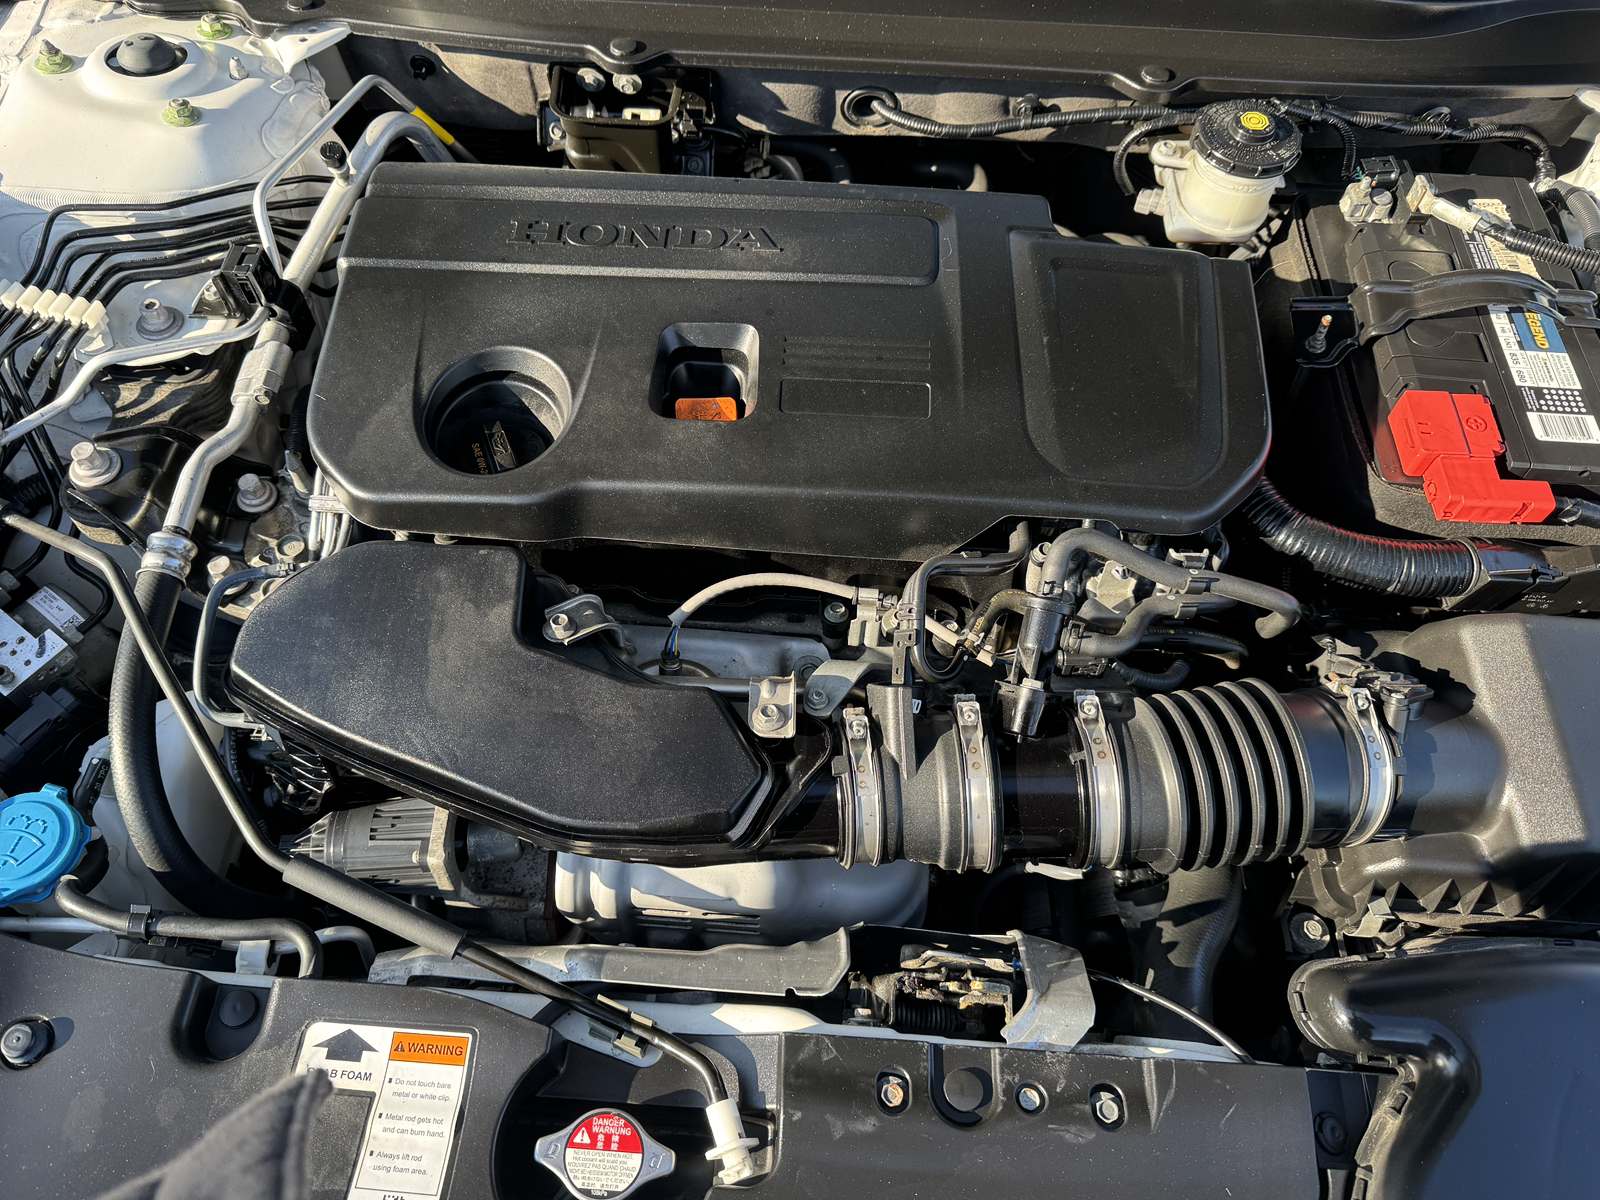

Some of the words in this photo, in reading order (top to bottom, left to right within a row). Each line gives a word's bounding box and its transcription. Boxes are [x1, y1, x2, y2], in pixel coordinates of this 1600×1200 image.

[506, 220, 784, 252] HONDA
[1524, 308, 1550, 349] EGEND
[1509, 352, 1520, 365] 835
[1516, 370, 1527, 383] 680
[472, 443, 483, 457] SAE
[477, 458, 488, 475] 0W-2
[98, 765, 108, 778] TPC
[407, 1042, 463, 1056] WARNING
[340, 1070, 372, 1081] FOAM
[438, 1094, 451, 1102] clip.
[592, 1117, 625, 1127] DANGER
[410, 1128, 425, 1136] burn
[427, 1130, 445, 1138] hand.
[592, 1125, 632, 1136] WARNUNG
[376, 1151, 400, 1160] Always
[373, 1164, 391, 1173] using
[393, 1165, 410, 1173] foam
